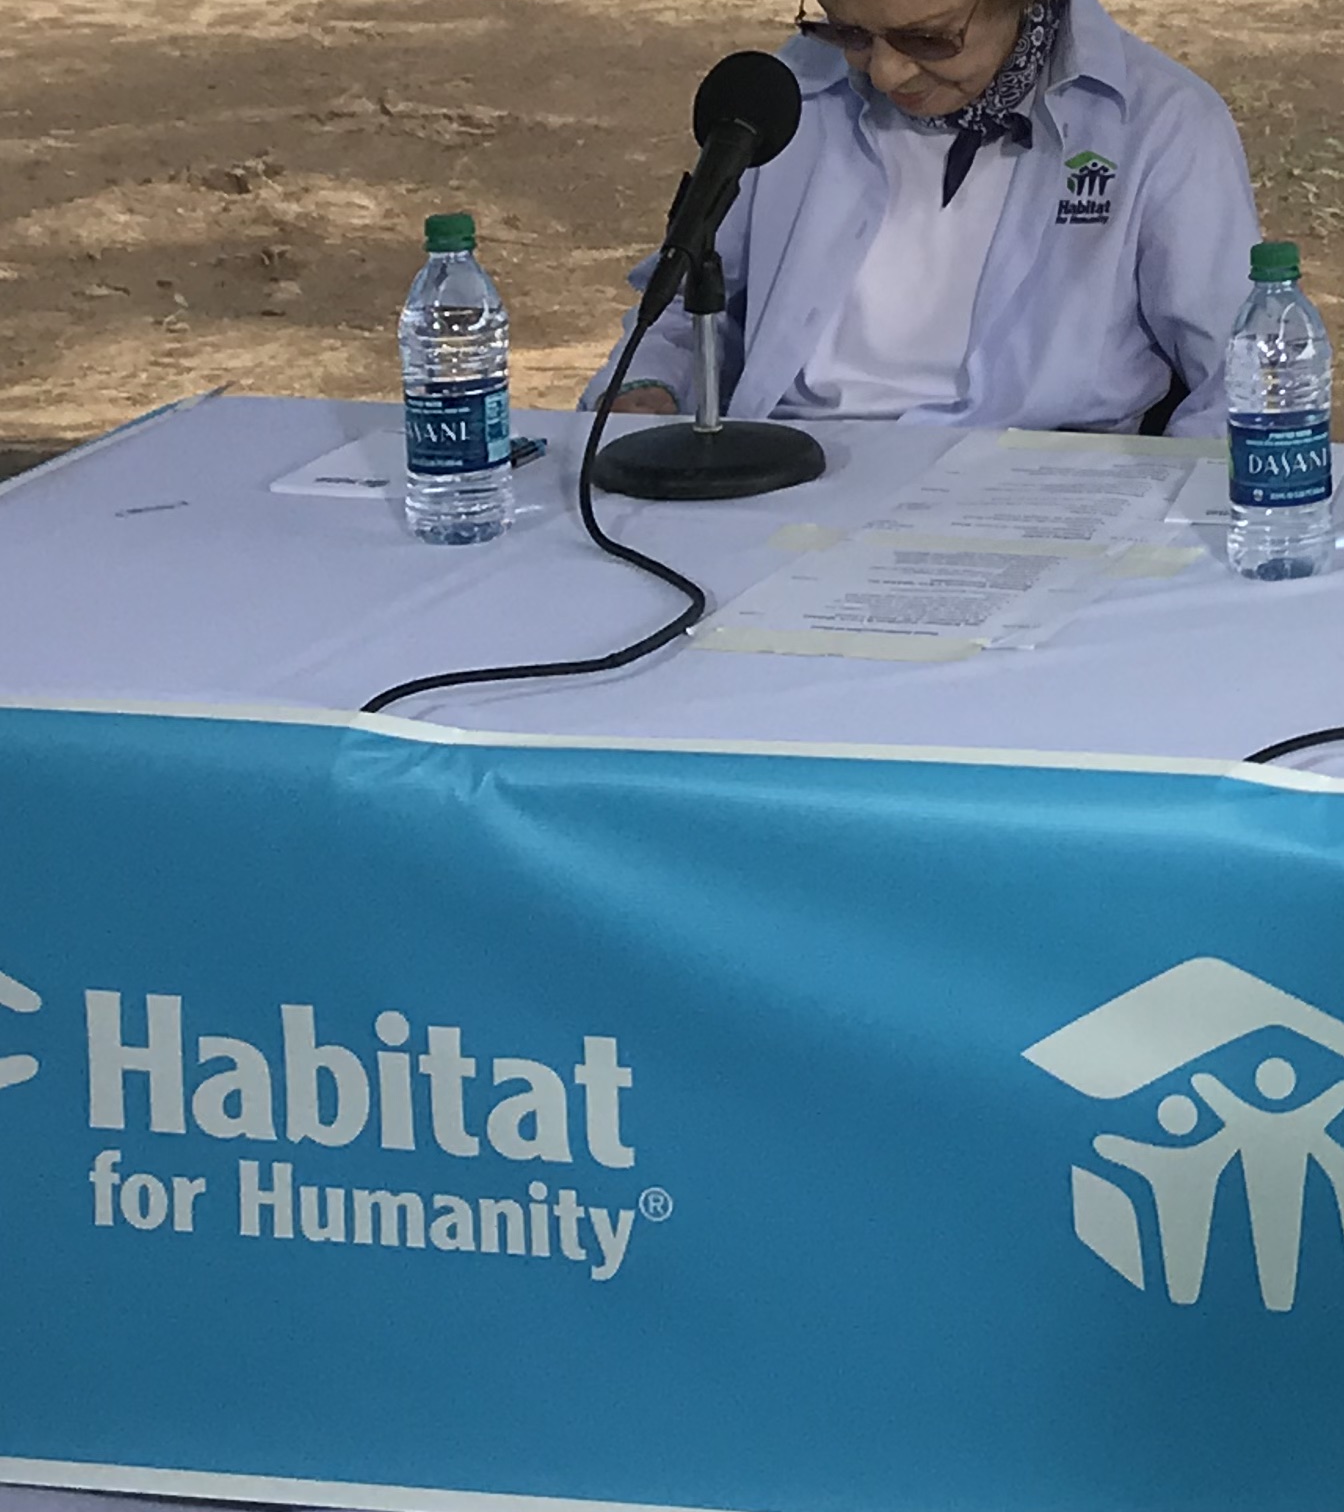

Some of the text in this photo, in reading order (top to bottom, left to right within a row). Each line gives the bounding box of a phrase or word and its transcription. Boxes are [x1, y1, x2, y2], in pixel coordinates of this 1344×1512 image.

[1058, 200, 1110, 215] Habitat
[1248, 448, 1328, 478] DASANI
[84, 988, 635, 1169] Habitat
[89, 1149, 206, 1232] for
